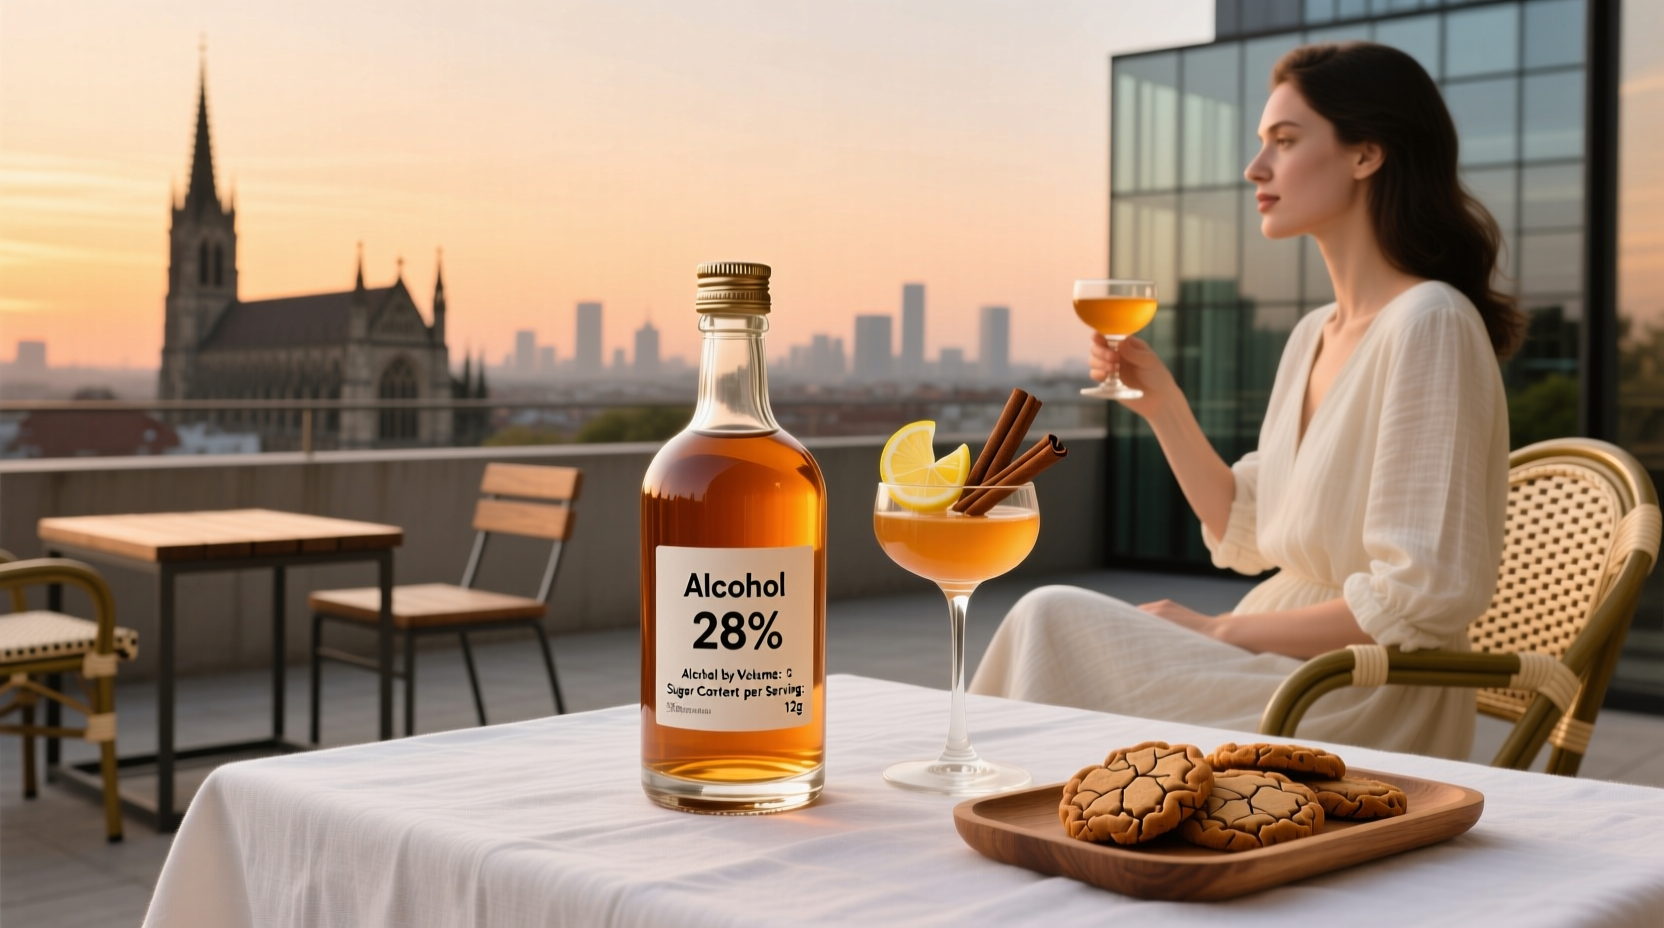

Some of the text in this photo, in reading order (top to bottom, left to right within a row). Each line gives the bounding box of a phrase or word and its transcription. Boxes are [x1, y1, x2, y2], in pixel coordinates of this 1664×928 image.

[683, 571, 785, 598] Alcohol
[693, 610, 783, 650] 28%
[744, 688, 763, 701] per
[785, 700, 803, 716] 12g
